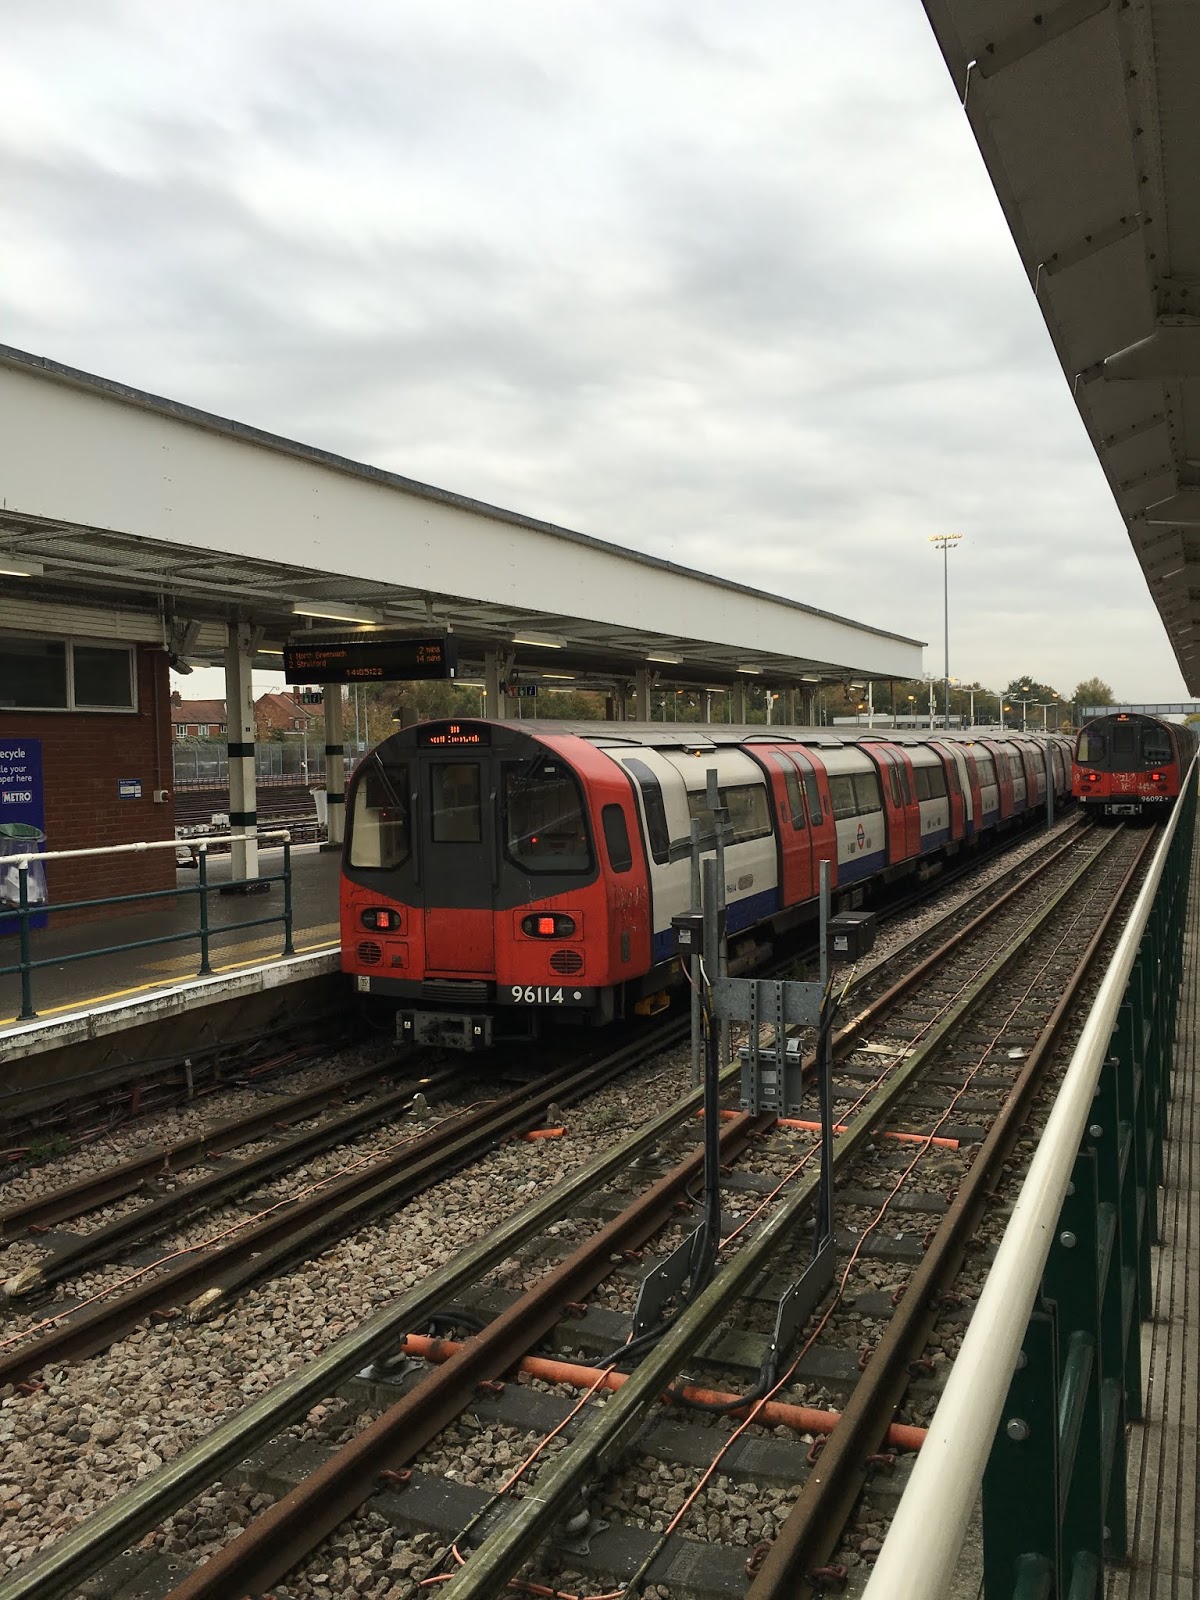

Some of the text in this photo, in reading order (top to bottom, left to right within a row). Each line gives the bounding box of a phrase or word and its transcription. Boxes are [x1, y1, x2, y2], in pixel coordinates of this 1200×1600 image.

[296, 652, 313, 660] North
[315, 650, 347, 660] Greenwich
[419, 646, 424, 654] 2
[289, 661, 294, 669] 2
[416, 655, 425, 663] 14
[427, 655, 441, 663] mins
[10, 766, 26, 774] your
[16, 774, 32, 782] here
[3, 792, 31, 803] METRO
[511, 985, 564, 1004] 96114
